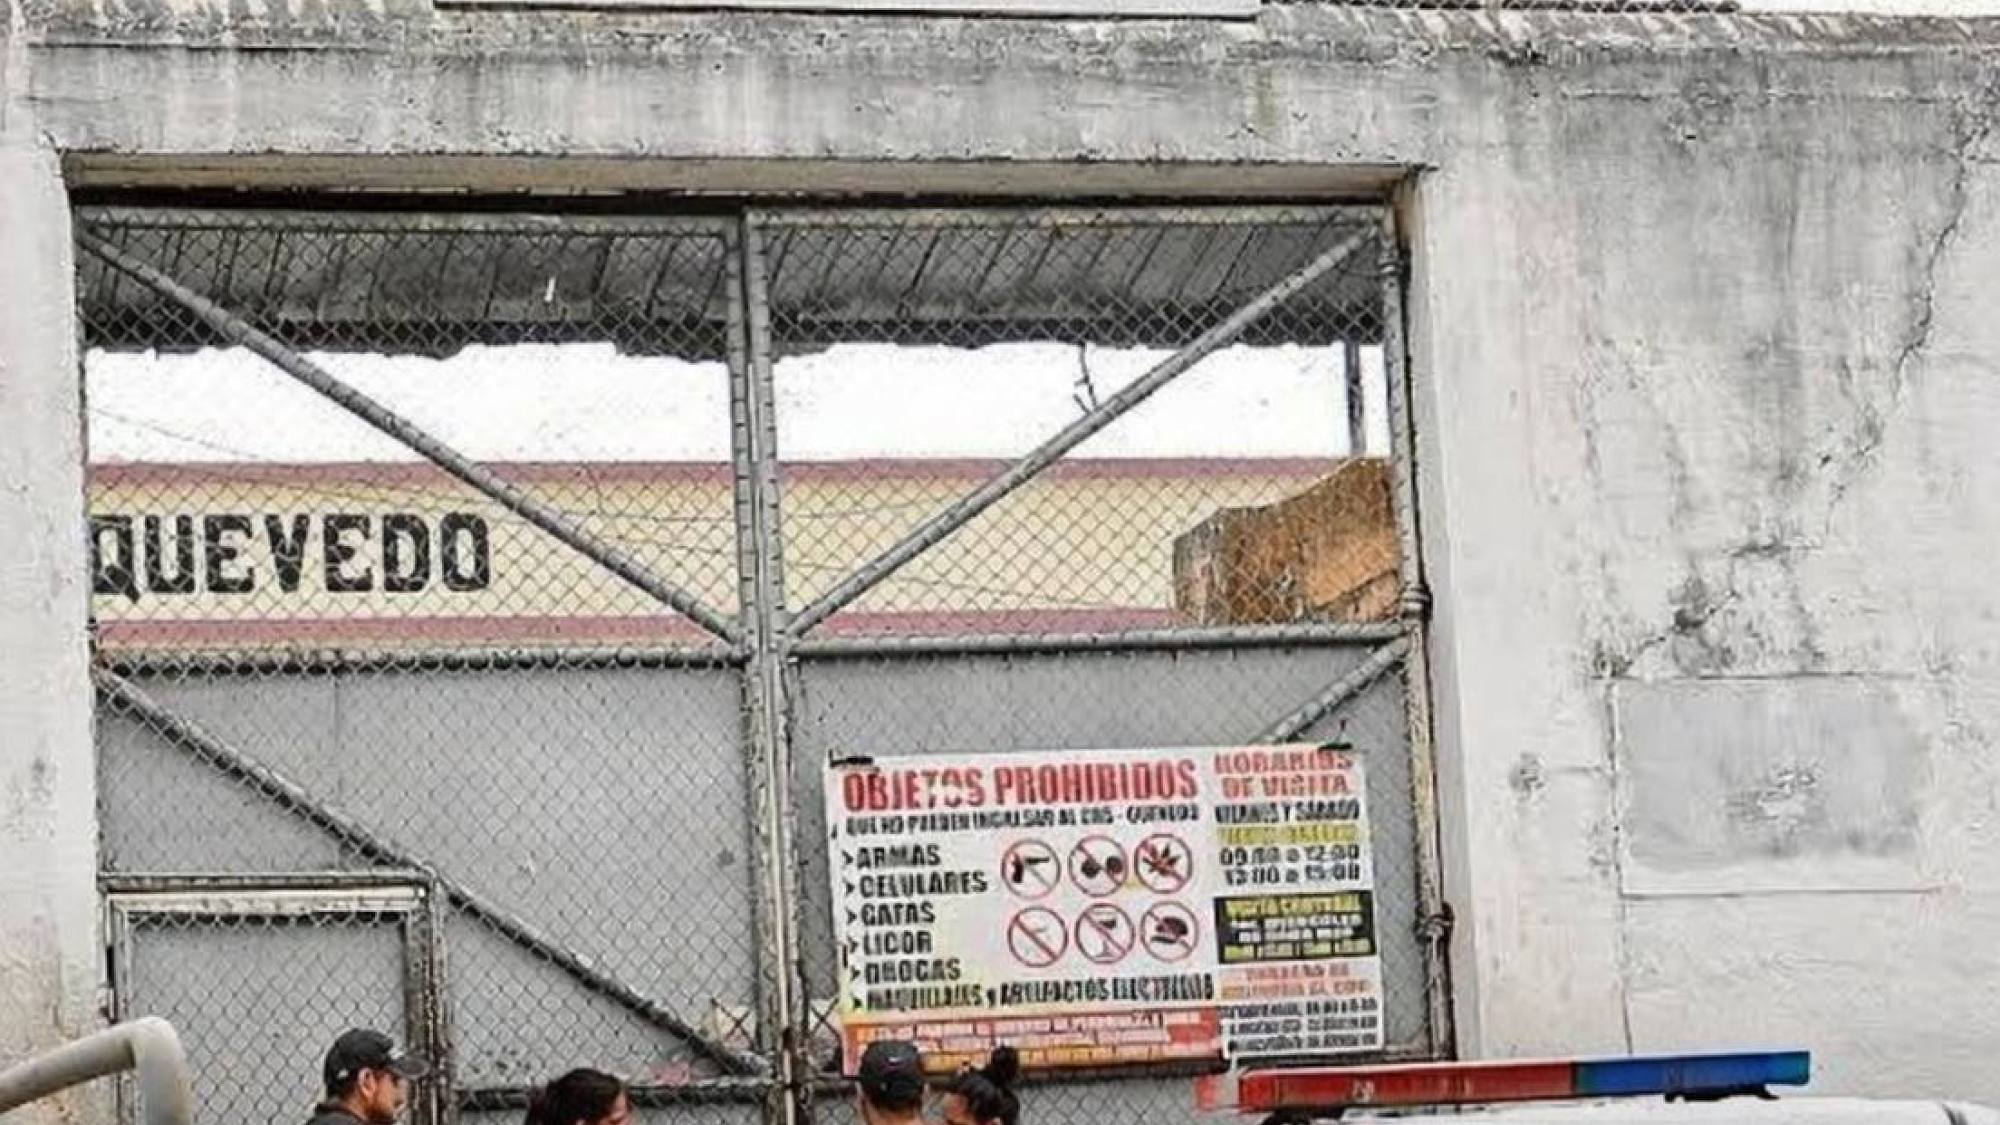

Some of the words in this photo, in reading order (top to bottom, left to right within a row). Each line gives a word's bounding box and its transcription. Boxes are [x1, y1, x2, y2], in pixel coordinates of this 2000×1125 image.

[92, 512, 490, 603] QUEVEDO
[843, 769, 985, 812] OBJETOS
[993, 759, 1199, 805] PROHIBIDOS
[857, 844, 941, 869] ARMAS
[859, 870, 988, 899] CELULARES
[863, 930, 932, 955] LICOR
